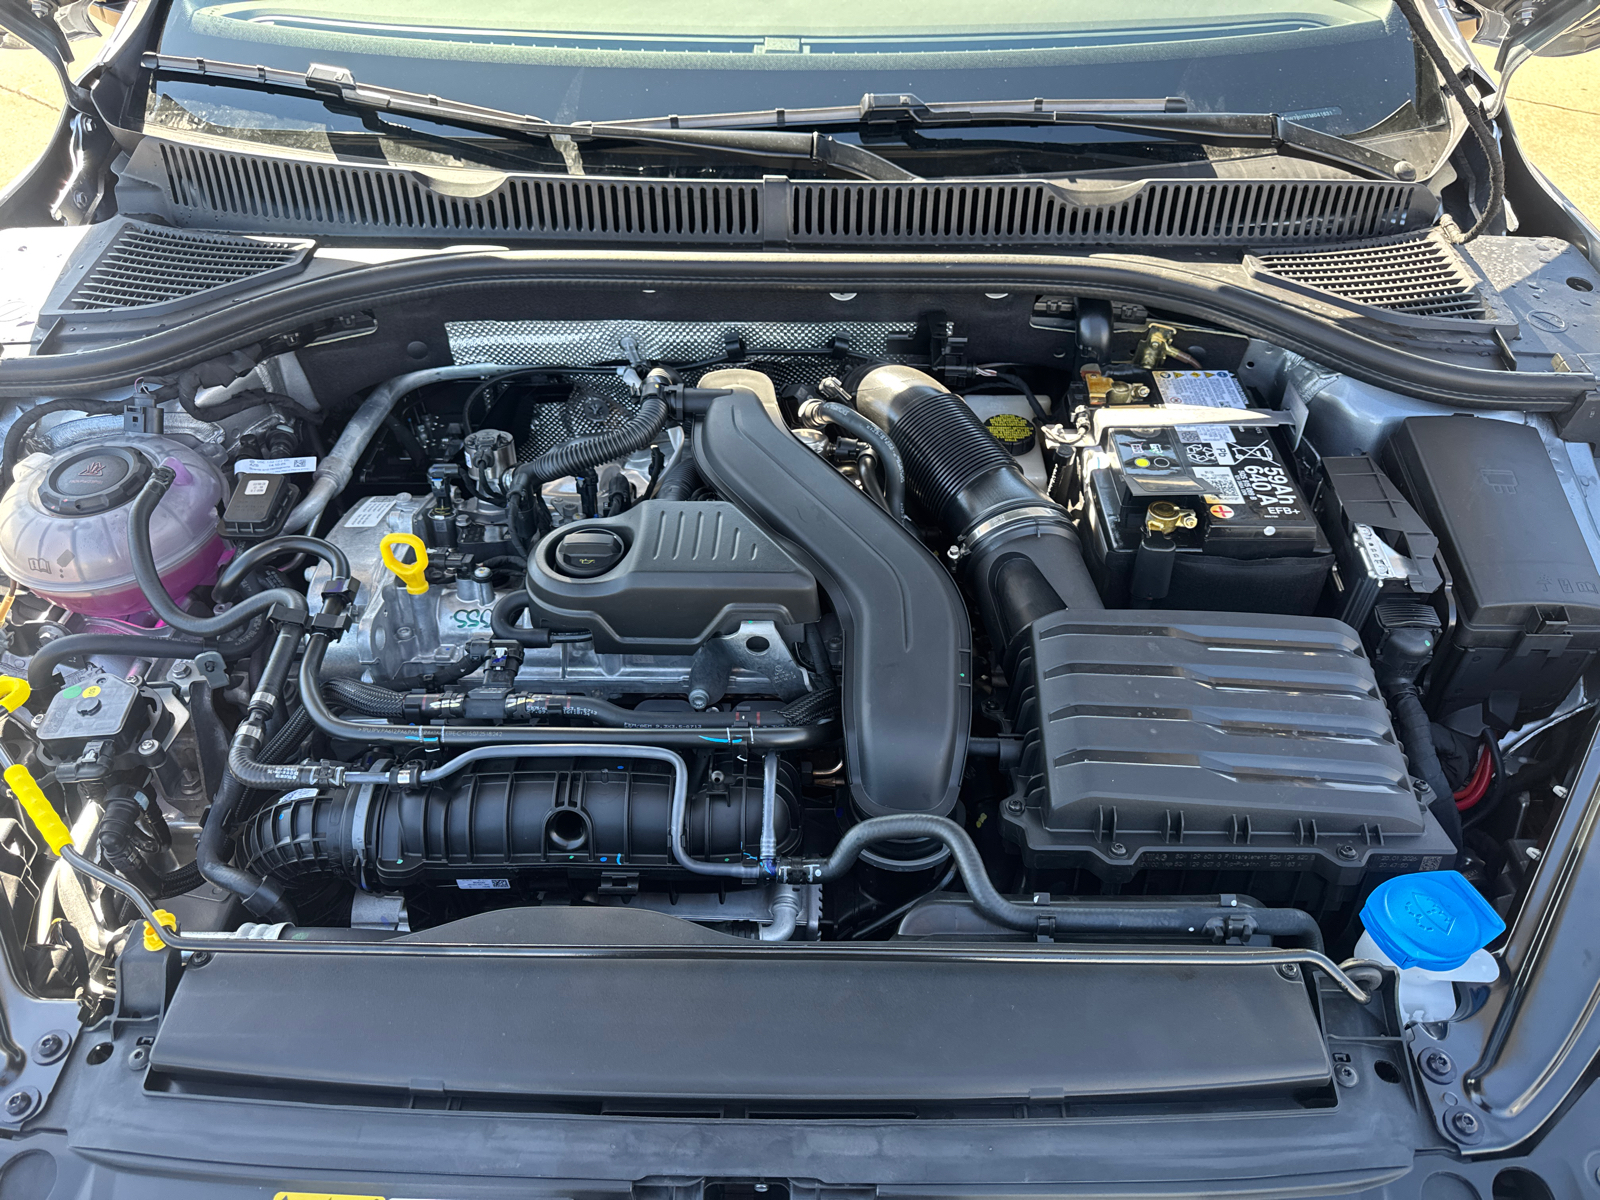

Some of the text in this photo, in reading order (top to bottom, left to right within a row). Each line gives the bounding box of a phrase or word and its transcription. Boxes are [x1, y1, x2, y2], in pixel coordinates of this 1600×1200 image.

[1216, 447, 1227, 458] Pb
[1244, 465, 1272, 491] 640
[1264, 466, 1297, 505] 59Ah
[1256, 494, 1279, 506] A
[1267, 506, 1301, 515] EFB+
